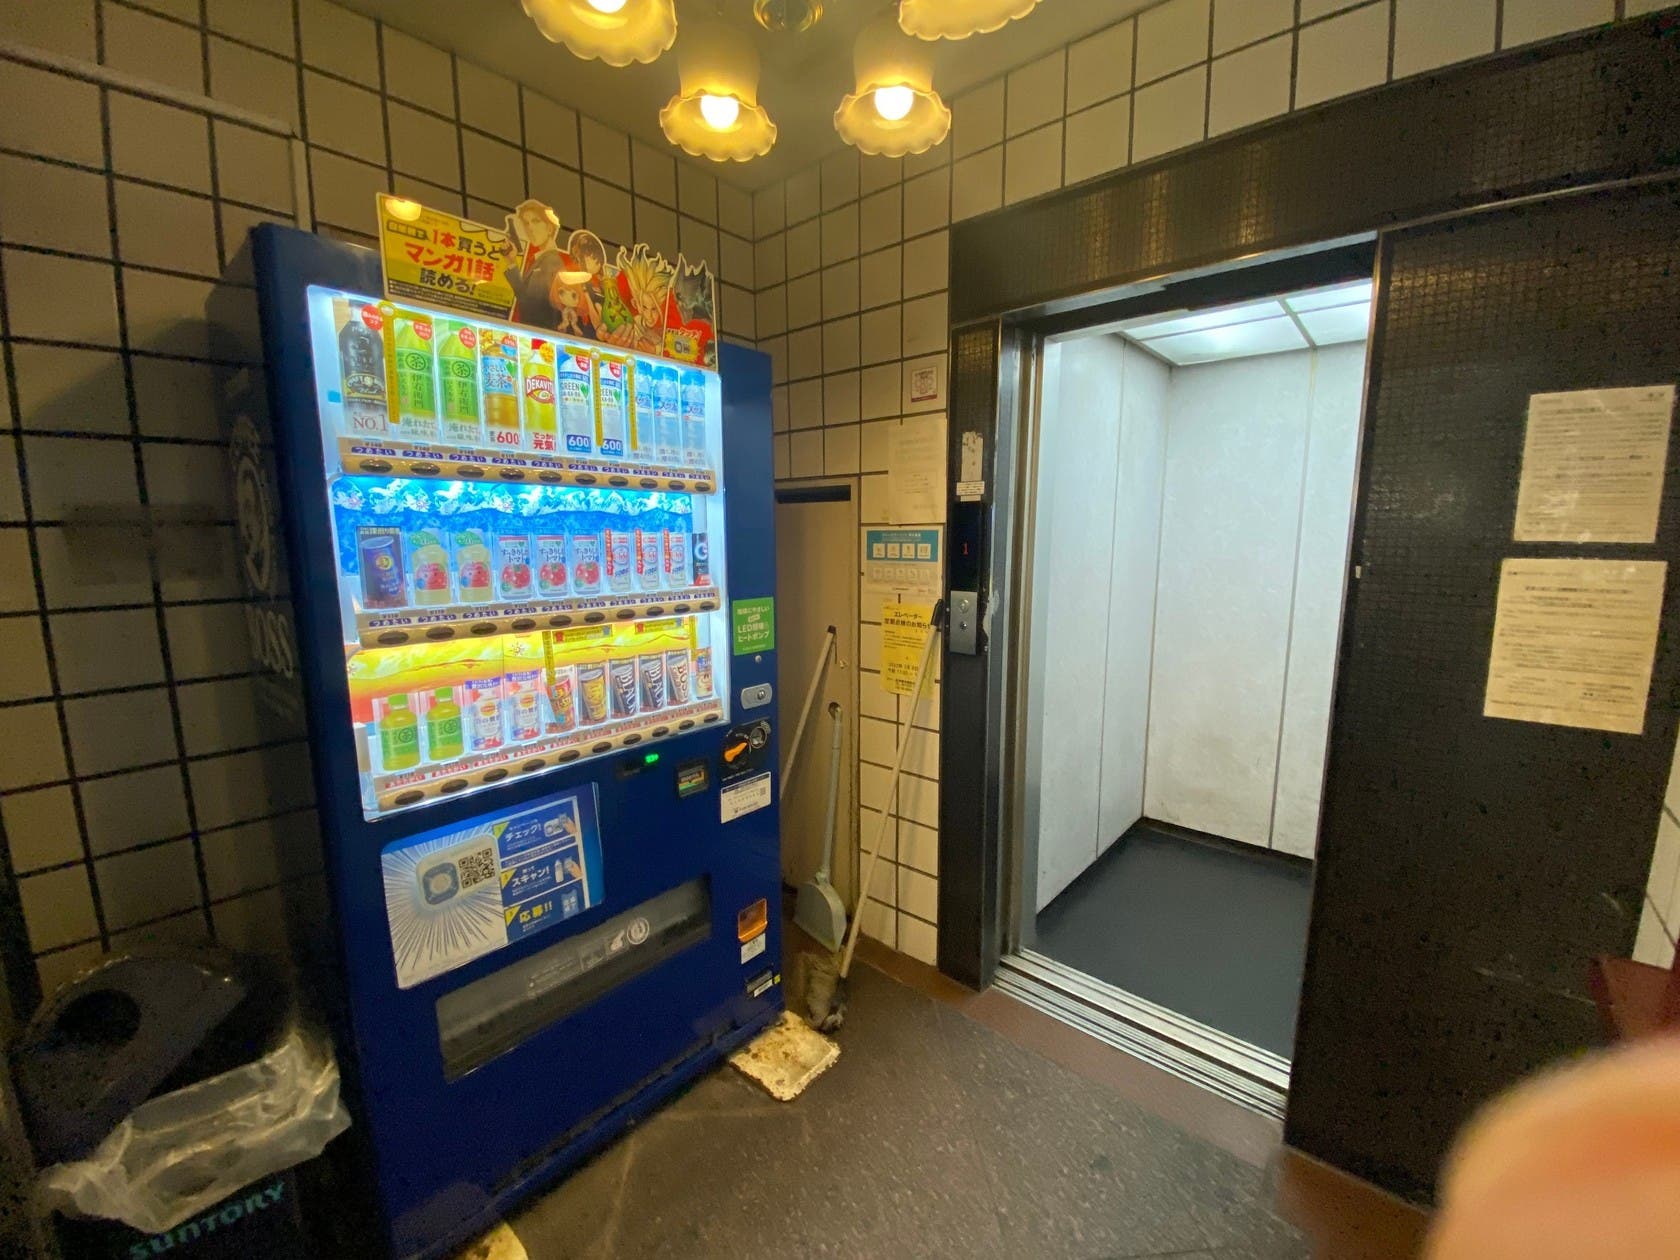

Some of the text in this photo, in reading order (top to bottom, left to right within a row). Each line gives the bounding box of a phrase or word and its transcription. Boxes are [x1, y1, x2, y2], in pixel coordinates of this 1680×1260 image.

[432, 229, 501, 261] 1本買うと
[405, 241, 494, 281] マンガ1話
[420, 268, 476, 295] 読める!
[568, 436, 589, 447] 600
[603, 440, 621, 450] 600
[894, 611, 922, 619] エレベーター
[505, 823, 541, 842] チェック!
[512, 866, 550, 887] スキャン!
